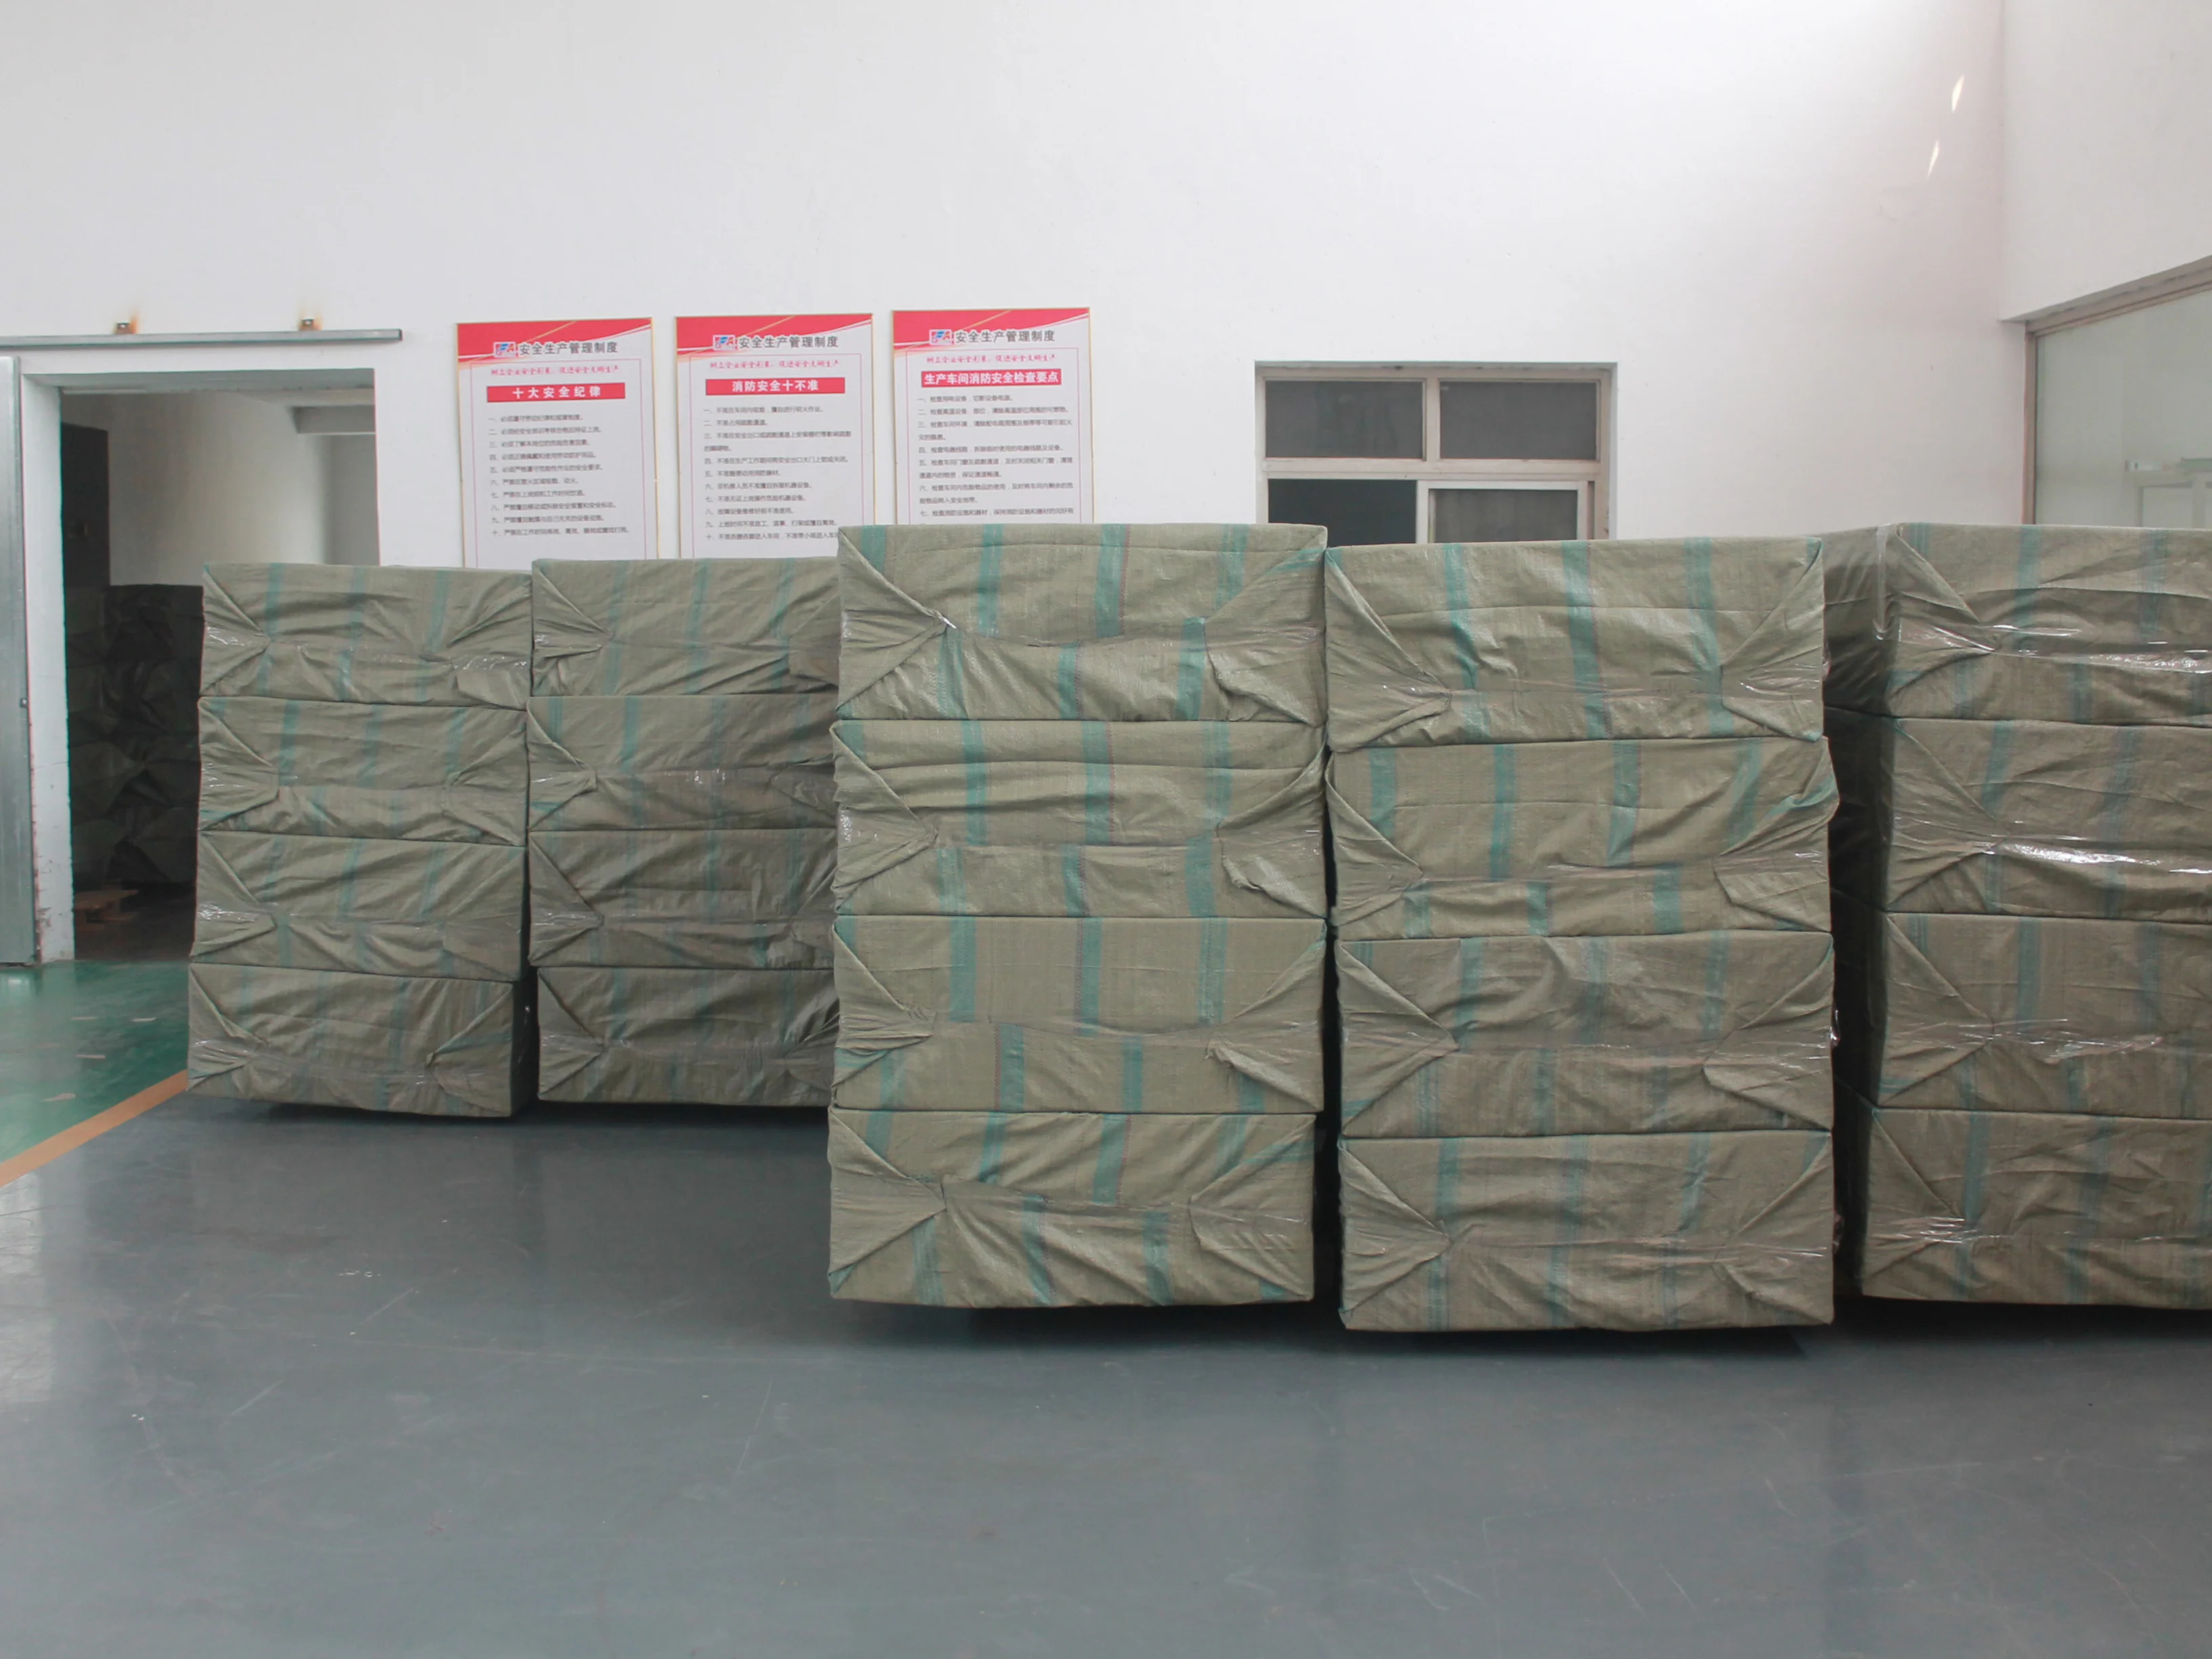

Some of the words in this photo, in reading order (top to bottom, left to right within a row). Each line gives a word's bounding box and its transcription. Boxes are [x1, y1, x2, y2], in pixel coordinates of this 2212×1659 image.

[739, 336, 838, 349] 安全生产管理制度
[956, 330, 1055, 343] 安全生产管理制度
[519, 341, 618, 356] 安全生产管理制度
[924, 371, 1059, 385] 生产车间消防安全检查要点
[512, 386, 601, 398] 十大安全纪律
[732, 380, 819, 392] 消防安全十不准
